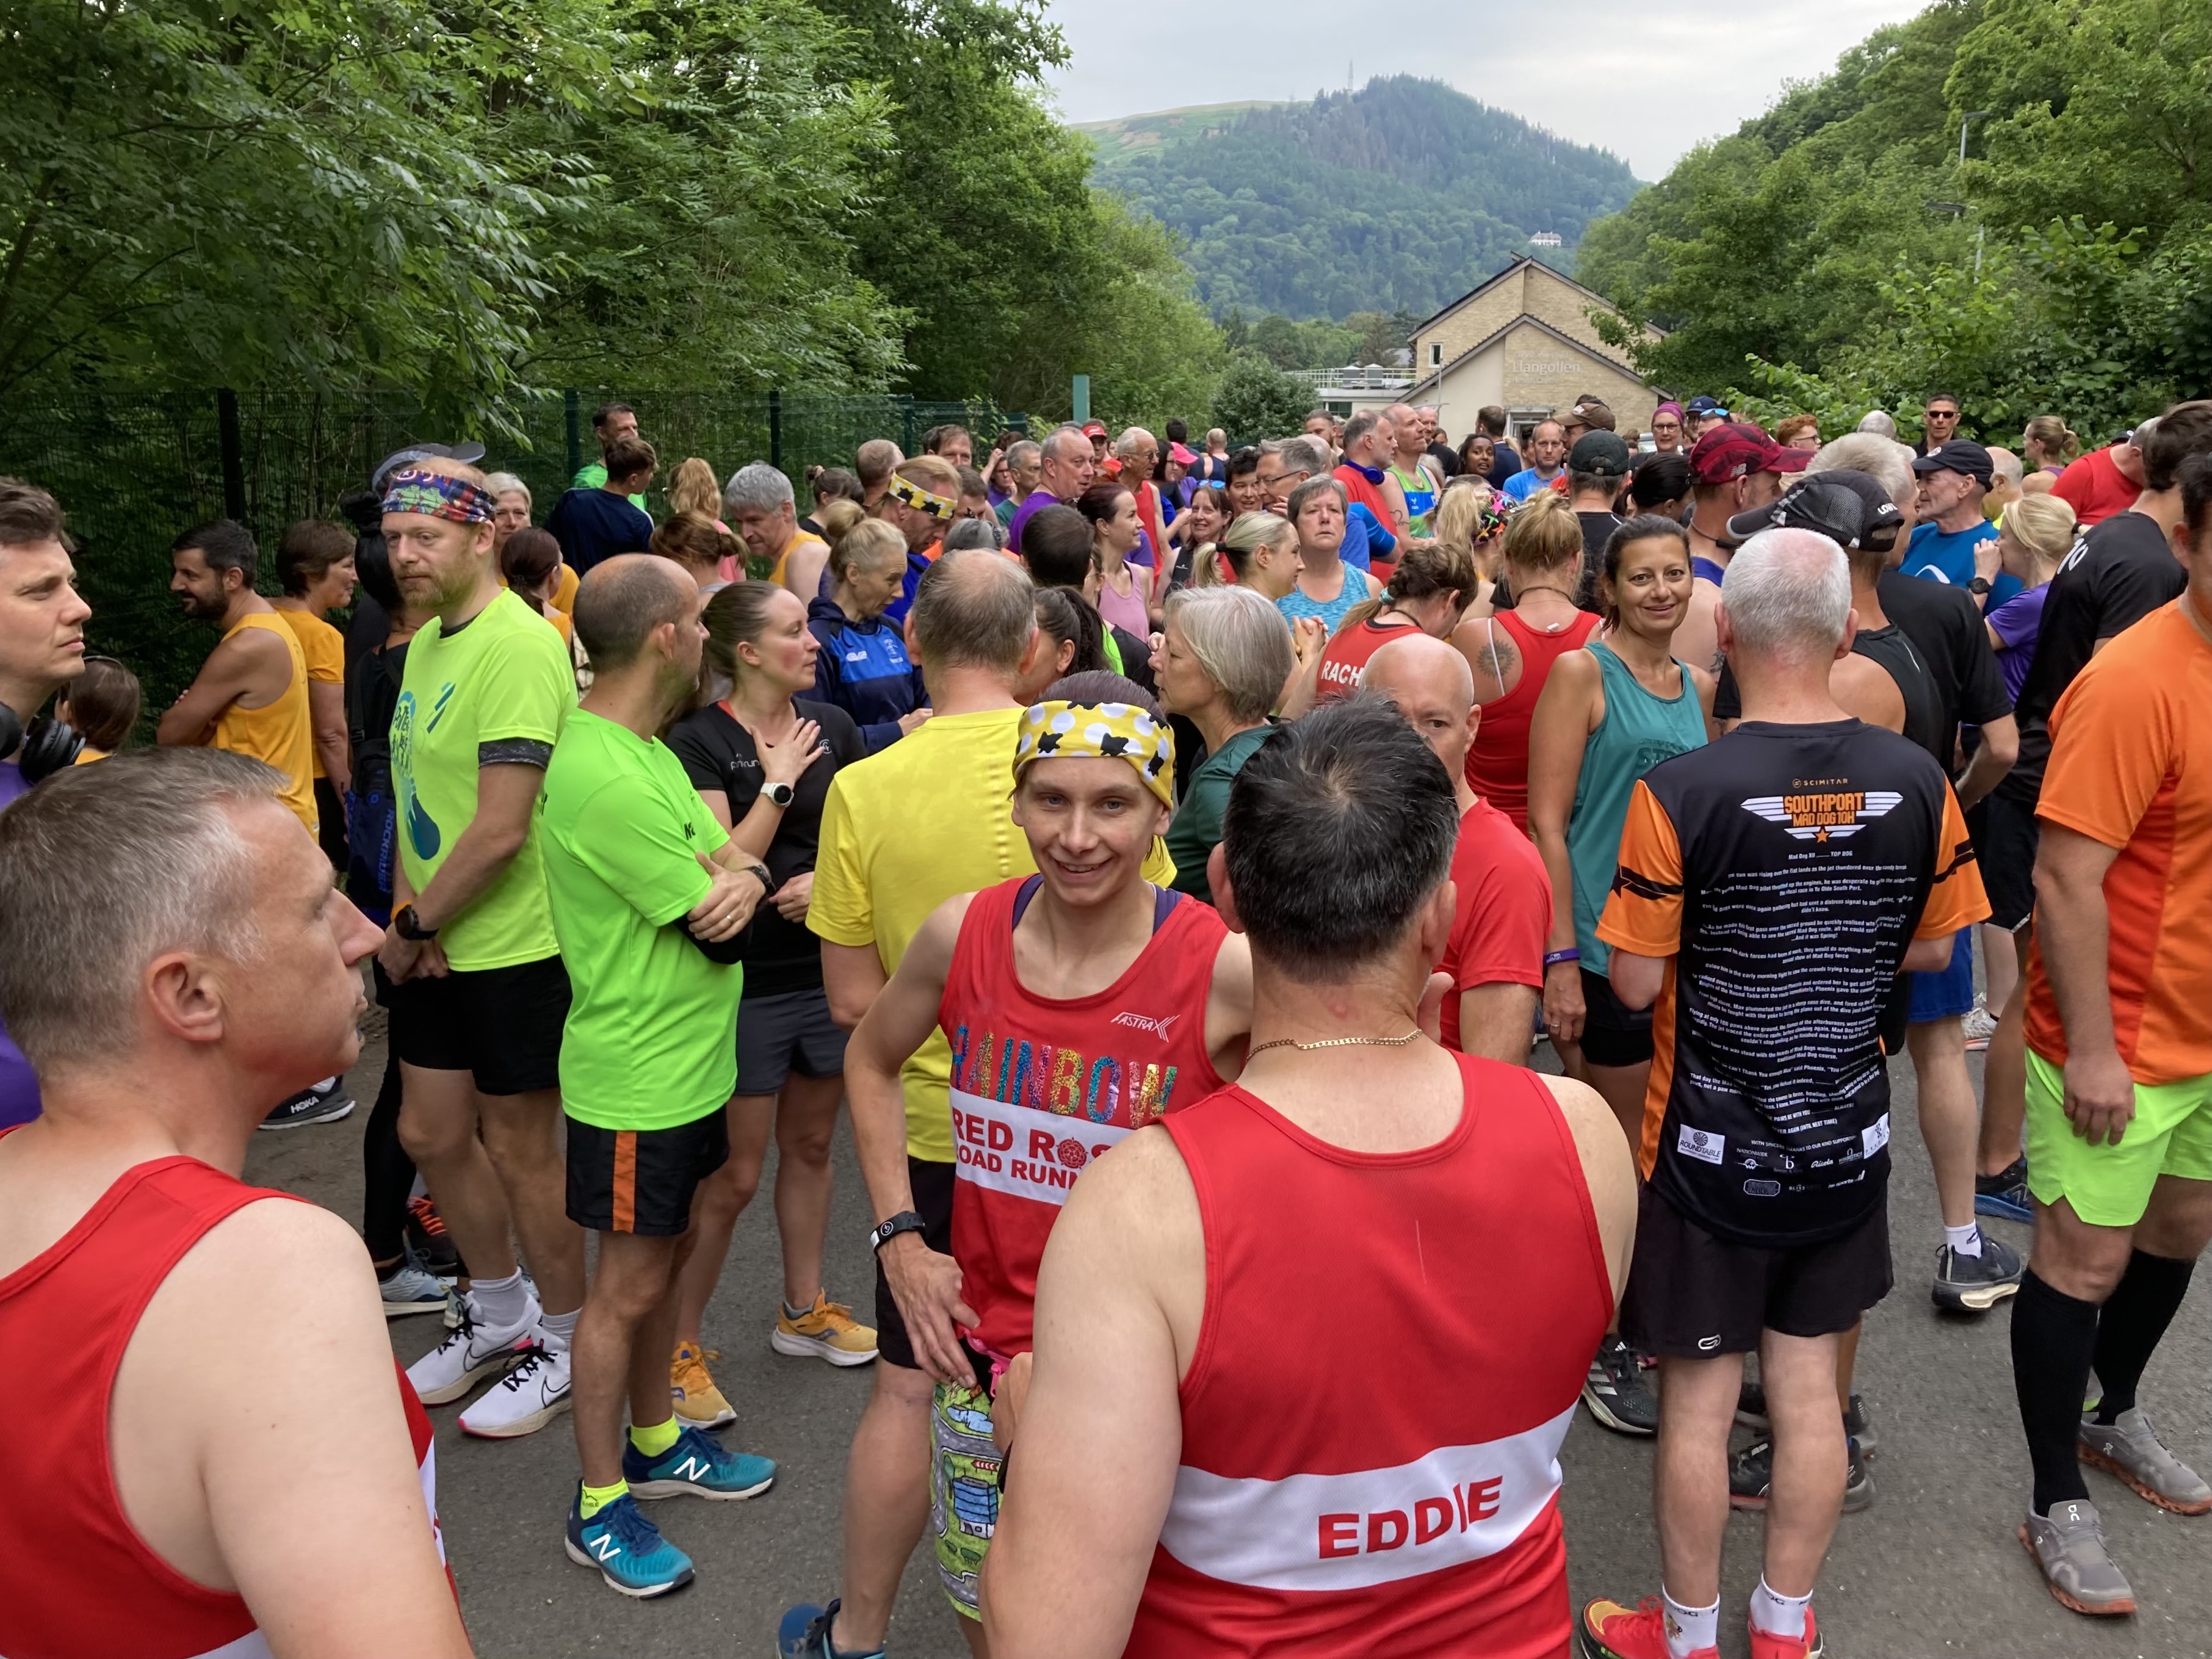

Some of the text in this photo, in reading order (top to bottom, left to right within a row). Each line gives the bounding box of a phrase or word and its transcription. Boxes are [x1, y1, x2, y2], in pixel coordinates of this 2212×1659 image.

[1513, 360, 1580, 375] Llangollen
[1784, 792, 1864, 814] SOUTHPORT
[1793, 812, 1815, 827] MAD
[1816, 812, 1837, 825] DOG
[290, 1096, 320, 1114] HOKA
[952, 1106, 1014, 1152] RED
[955, 1143, 1002, 1173] OAD
[1318, 1475, 1503, 1559] EDDIE
